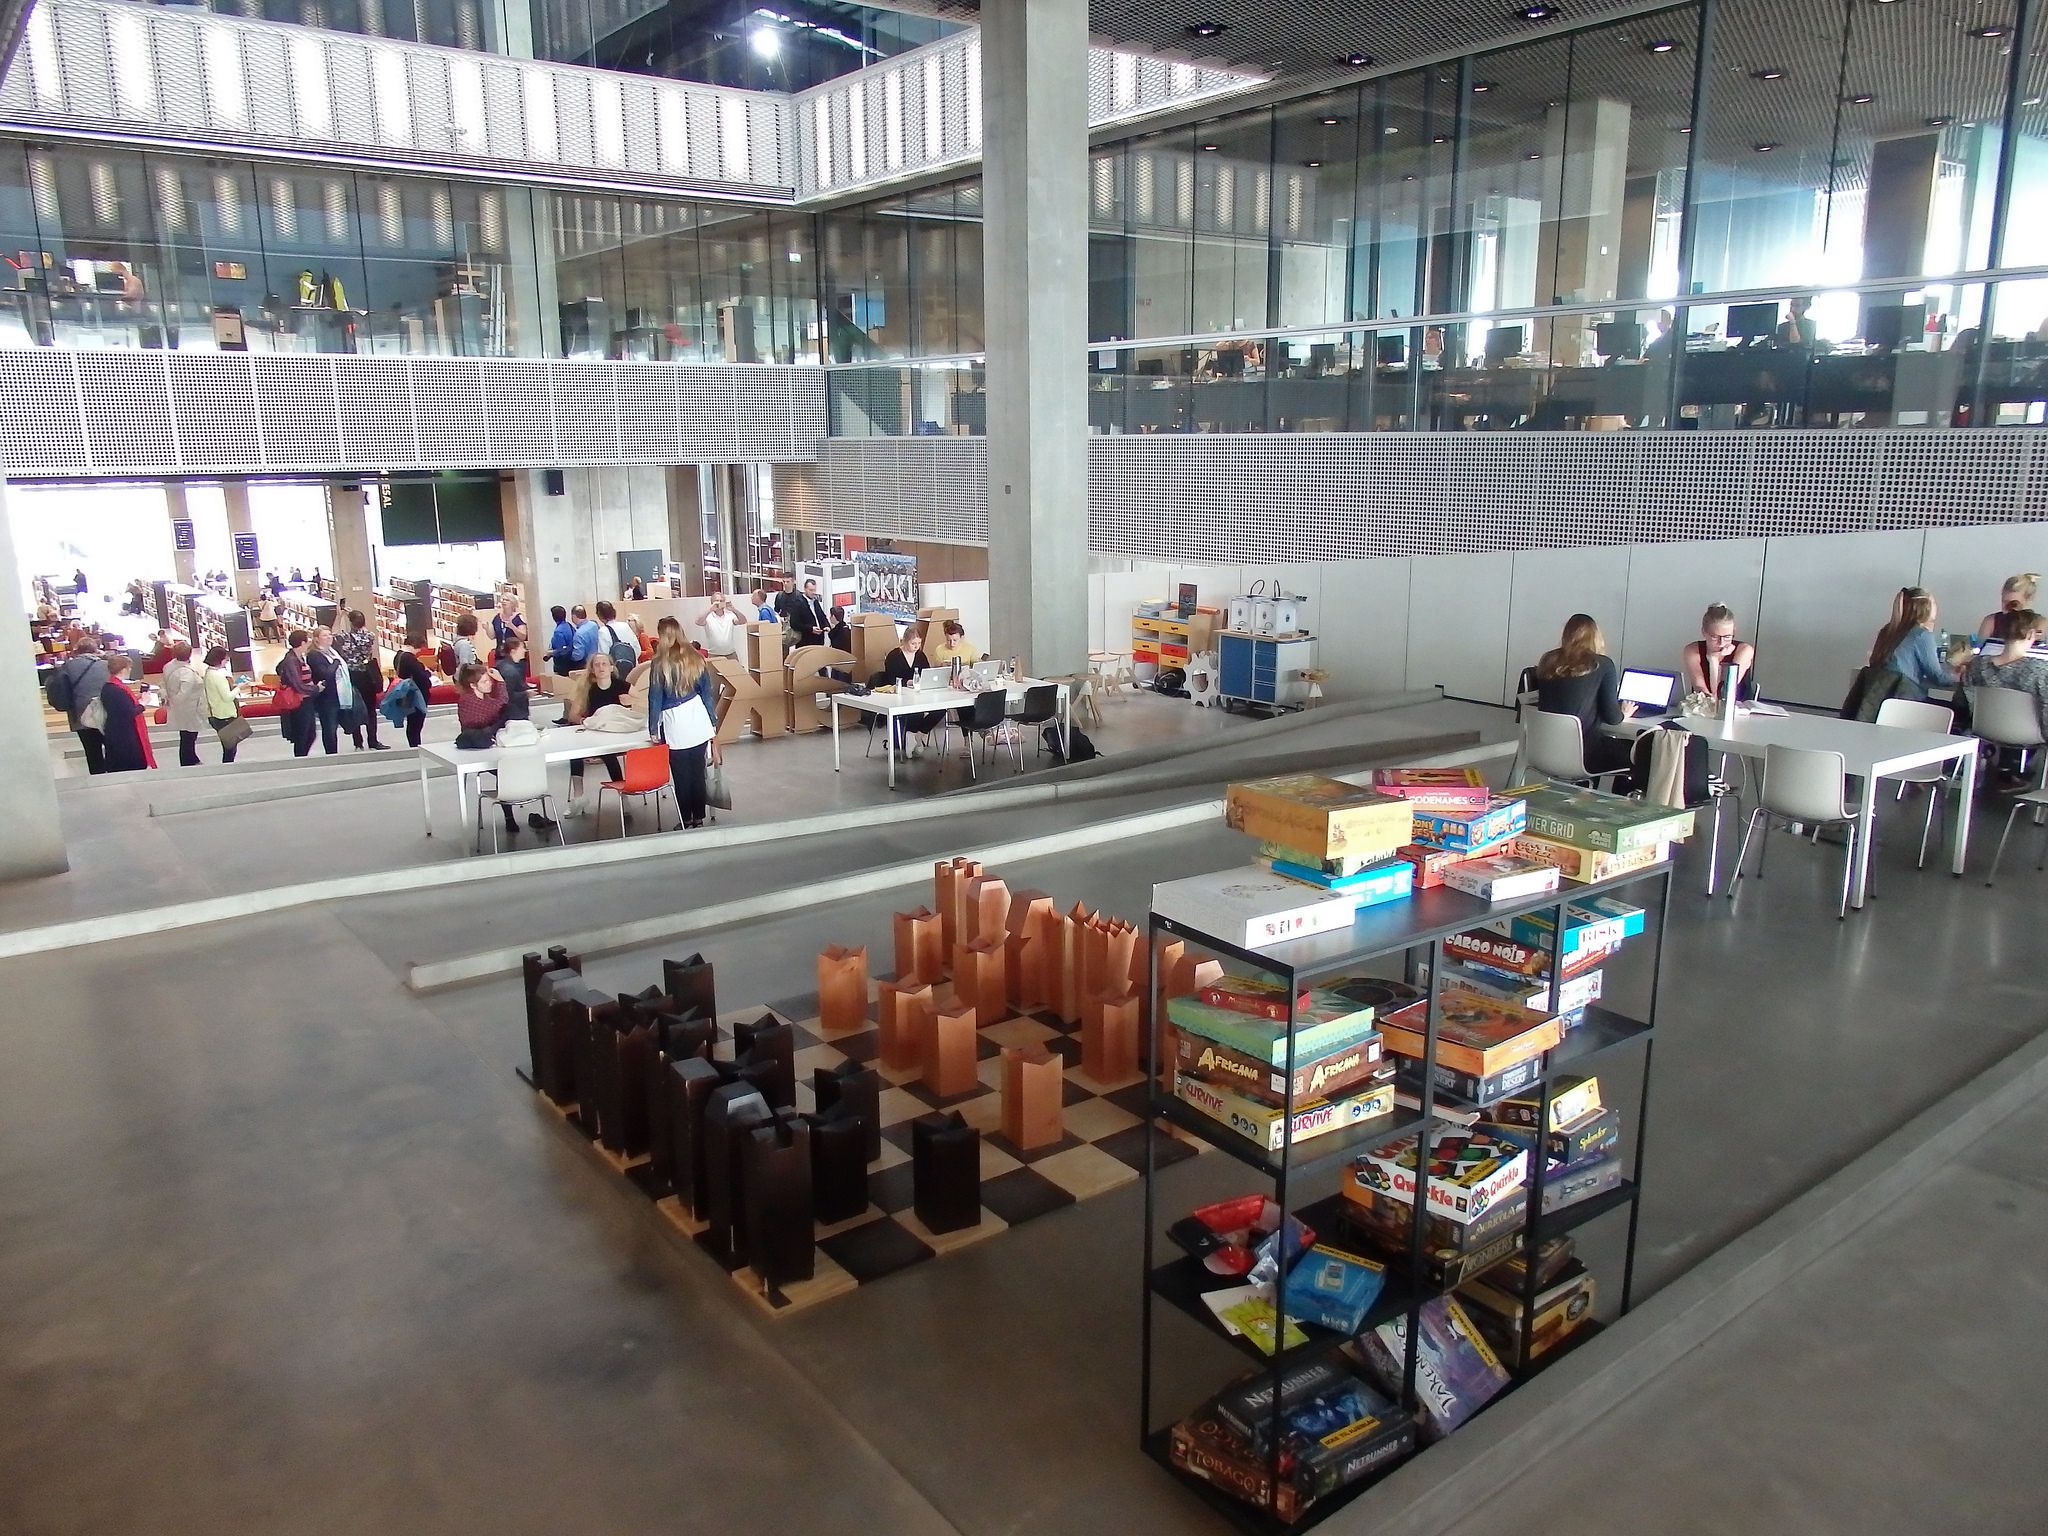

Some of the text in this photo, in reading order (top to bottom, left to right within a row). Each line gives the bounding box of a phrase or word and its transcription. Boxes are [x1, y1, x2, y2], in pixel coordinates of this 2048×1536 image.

[380, 478, 392, 508] ESAL
[1409, 795, 1468, 805] CODENAMES
[1526, 815, 1547, 832] WER
[1550, 821, 1575, 839] GRID
[1445, 934, 1490, 955] CARGO
[1492, 944, 1527, 965] NOIR
[1198, 1047, 1259, 1081] AFRICANA
[1309, 1053, 1360, 1093] AFRICANA
[1186, 1083, 1224, 1113] SURVIVE
[1393, 1174, 1453, 1206] Qwkle
[1490, 1167, 1519, 1196] Qwirkle
[1464, 1235, 1513, 1271] WONDERS
[1245, 1365, 1329, 1408] NETUNNER
[1195, 1449, 1256, 1492] TOBAGO
[1347, 1440, 1398, 1472] NETRUNNER
